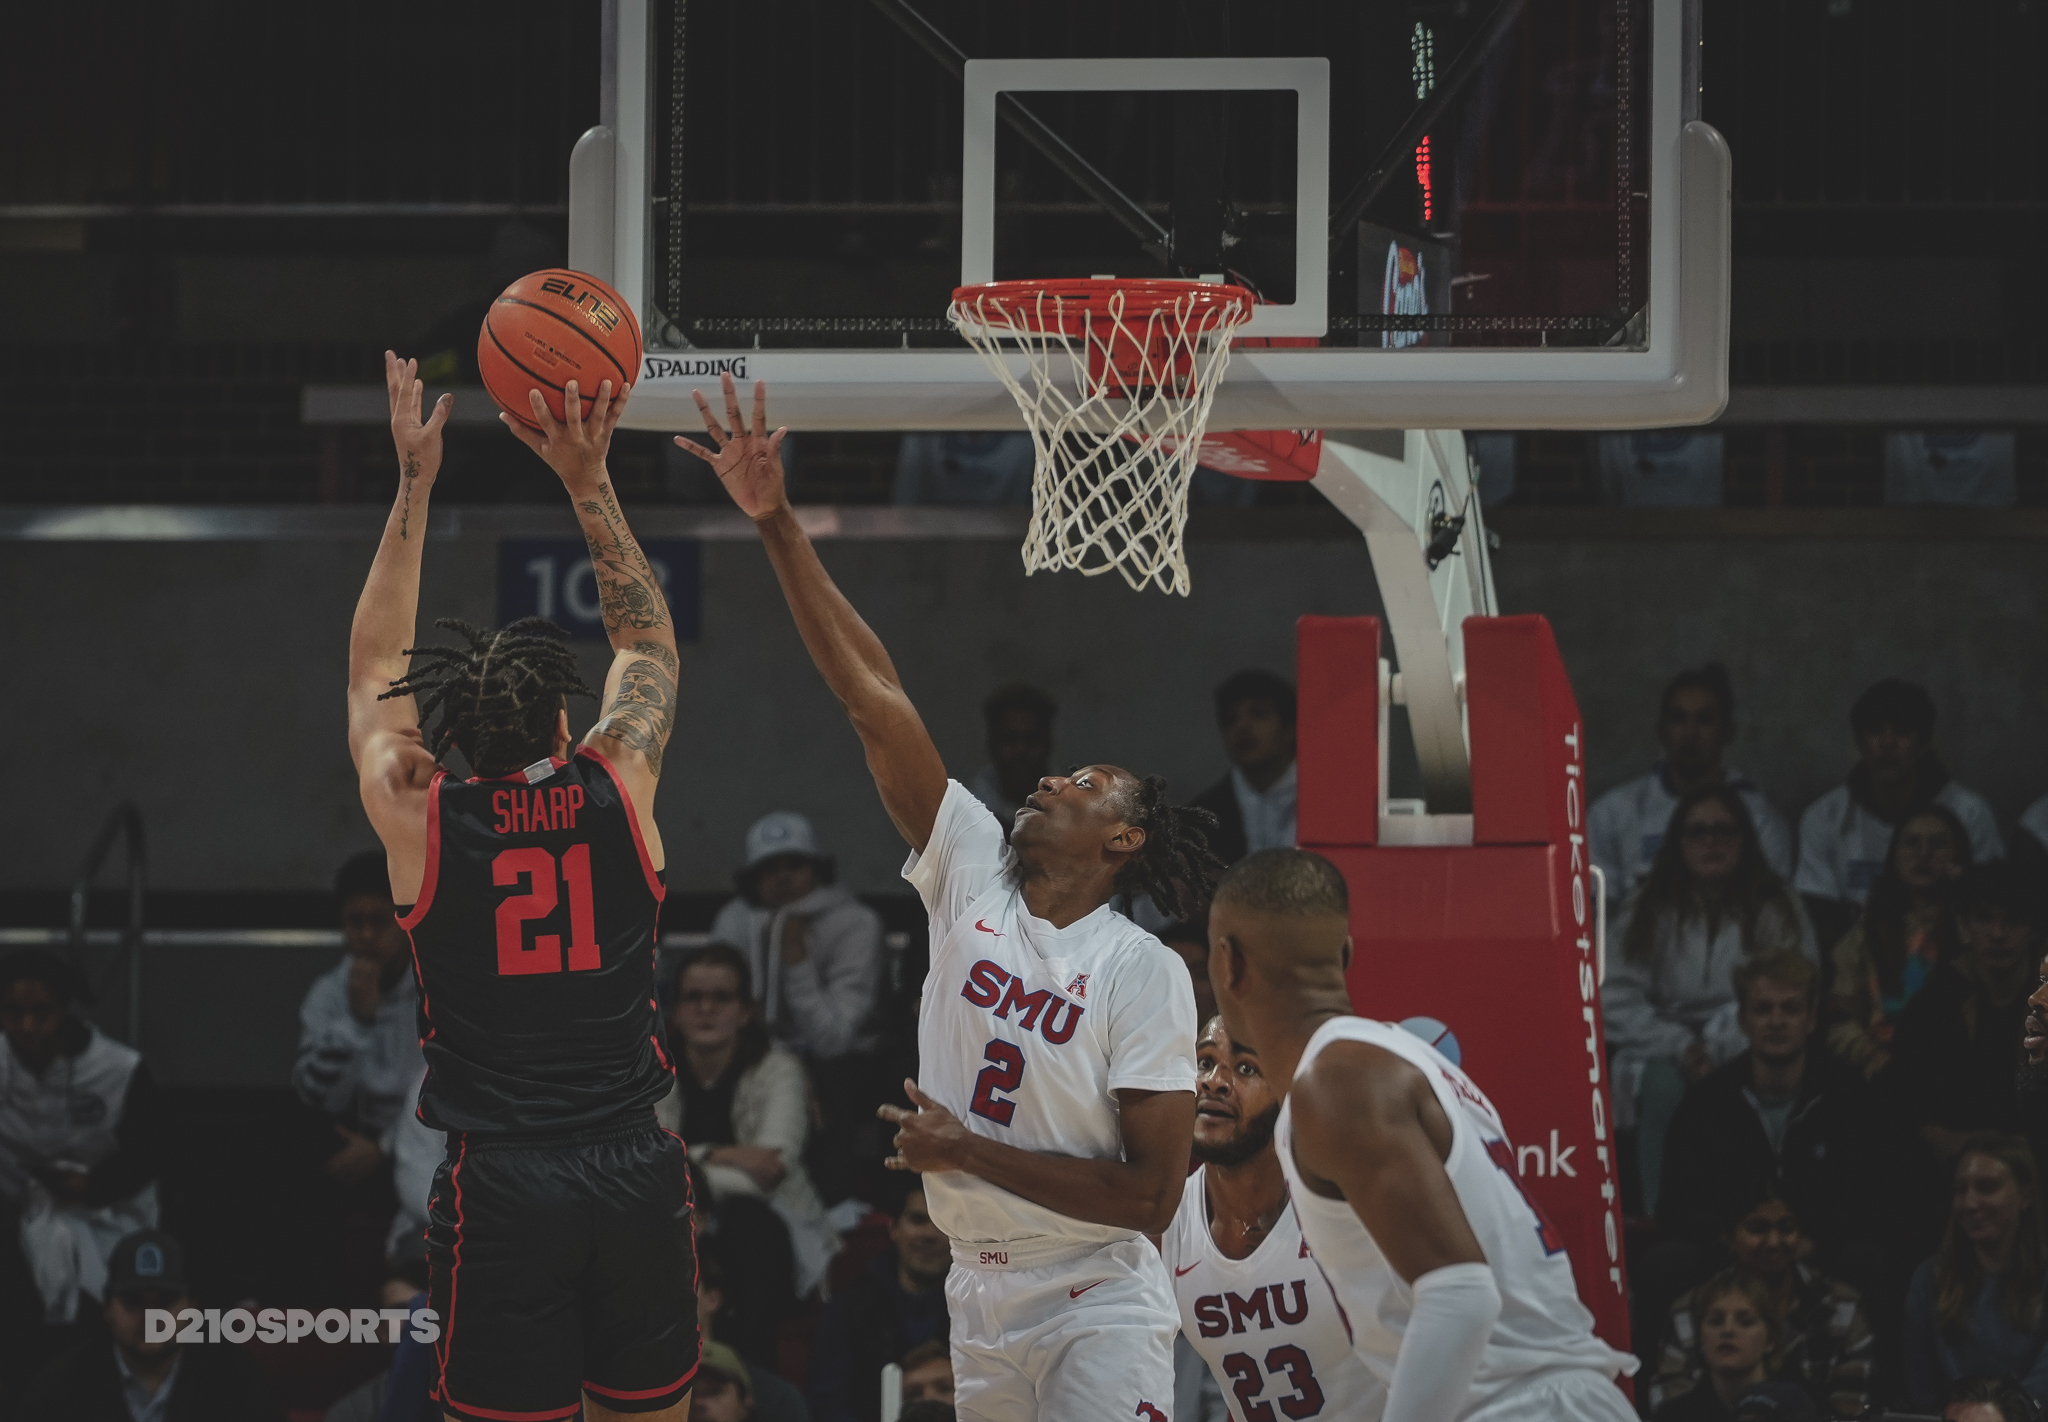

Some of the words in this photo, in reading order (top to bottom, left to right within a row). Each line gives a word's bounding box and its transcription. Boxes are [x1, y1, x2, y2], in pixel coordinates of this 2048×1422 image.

[541, 278, 620, 332] ELITE
[644, 356, 746, 380] SPALDING
[492, 784, 585, 834] SHARP
[491, 843, 601, 975] 21
[961, 959, 1086, 1045] SMU
[969, 1038, 1026, 1128] 2
[1517, 1129, 1578, 1177] nk
[979, 1252, 1009, 1265] SMU
[1194, 1279, 1309, 1339] SMU
[1222, 1343, 1326, 1422] 23
